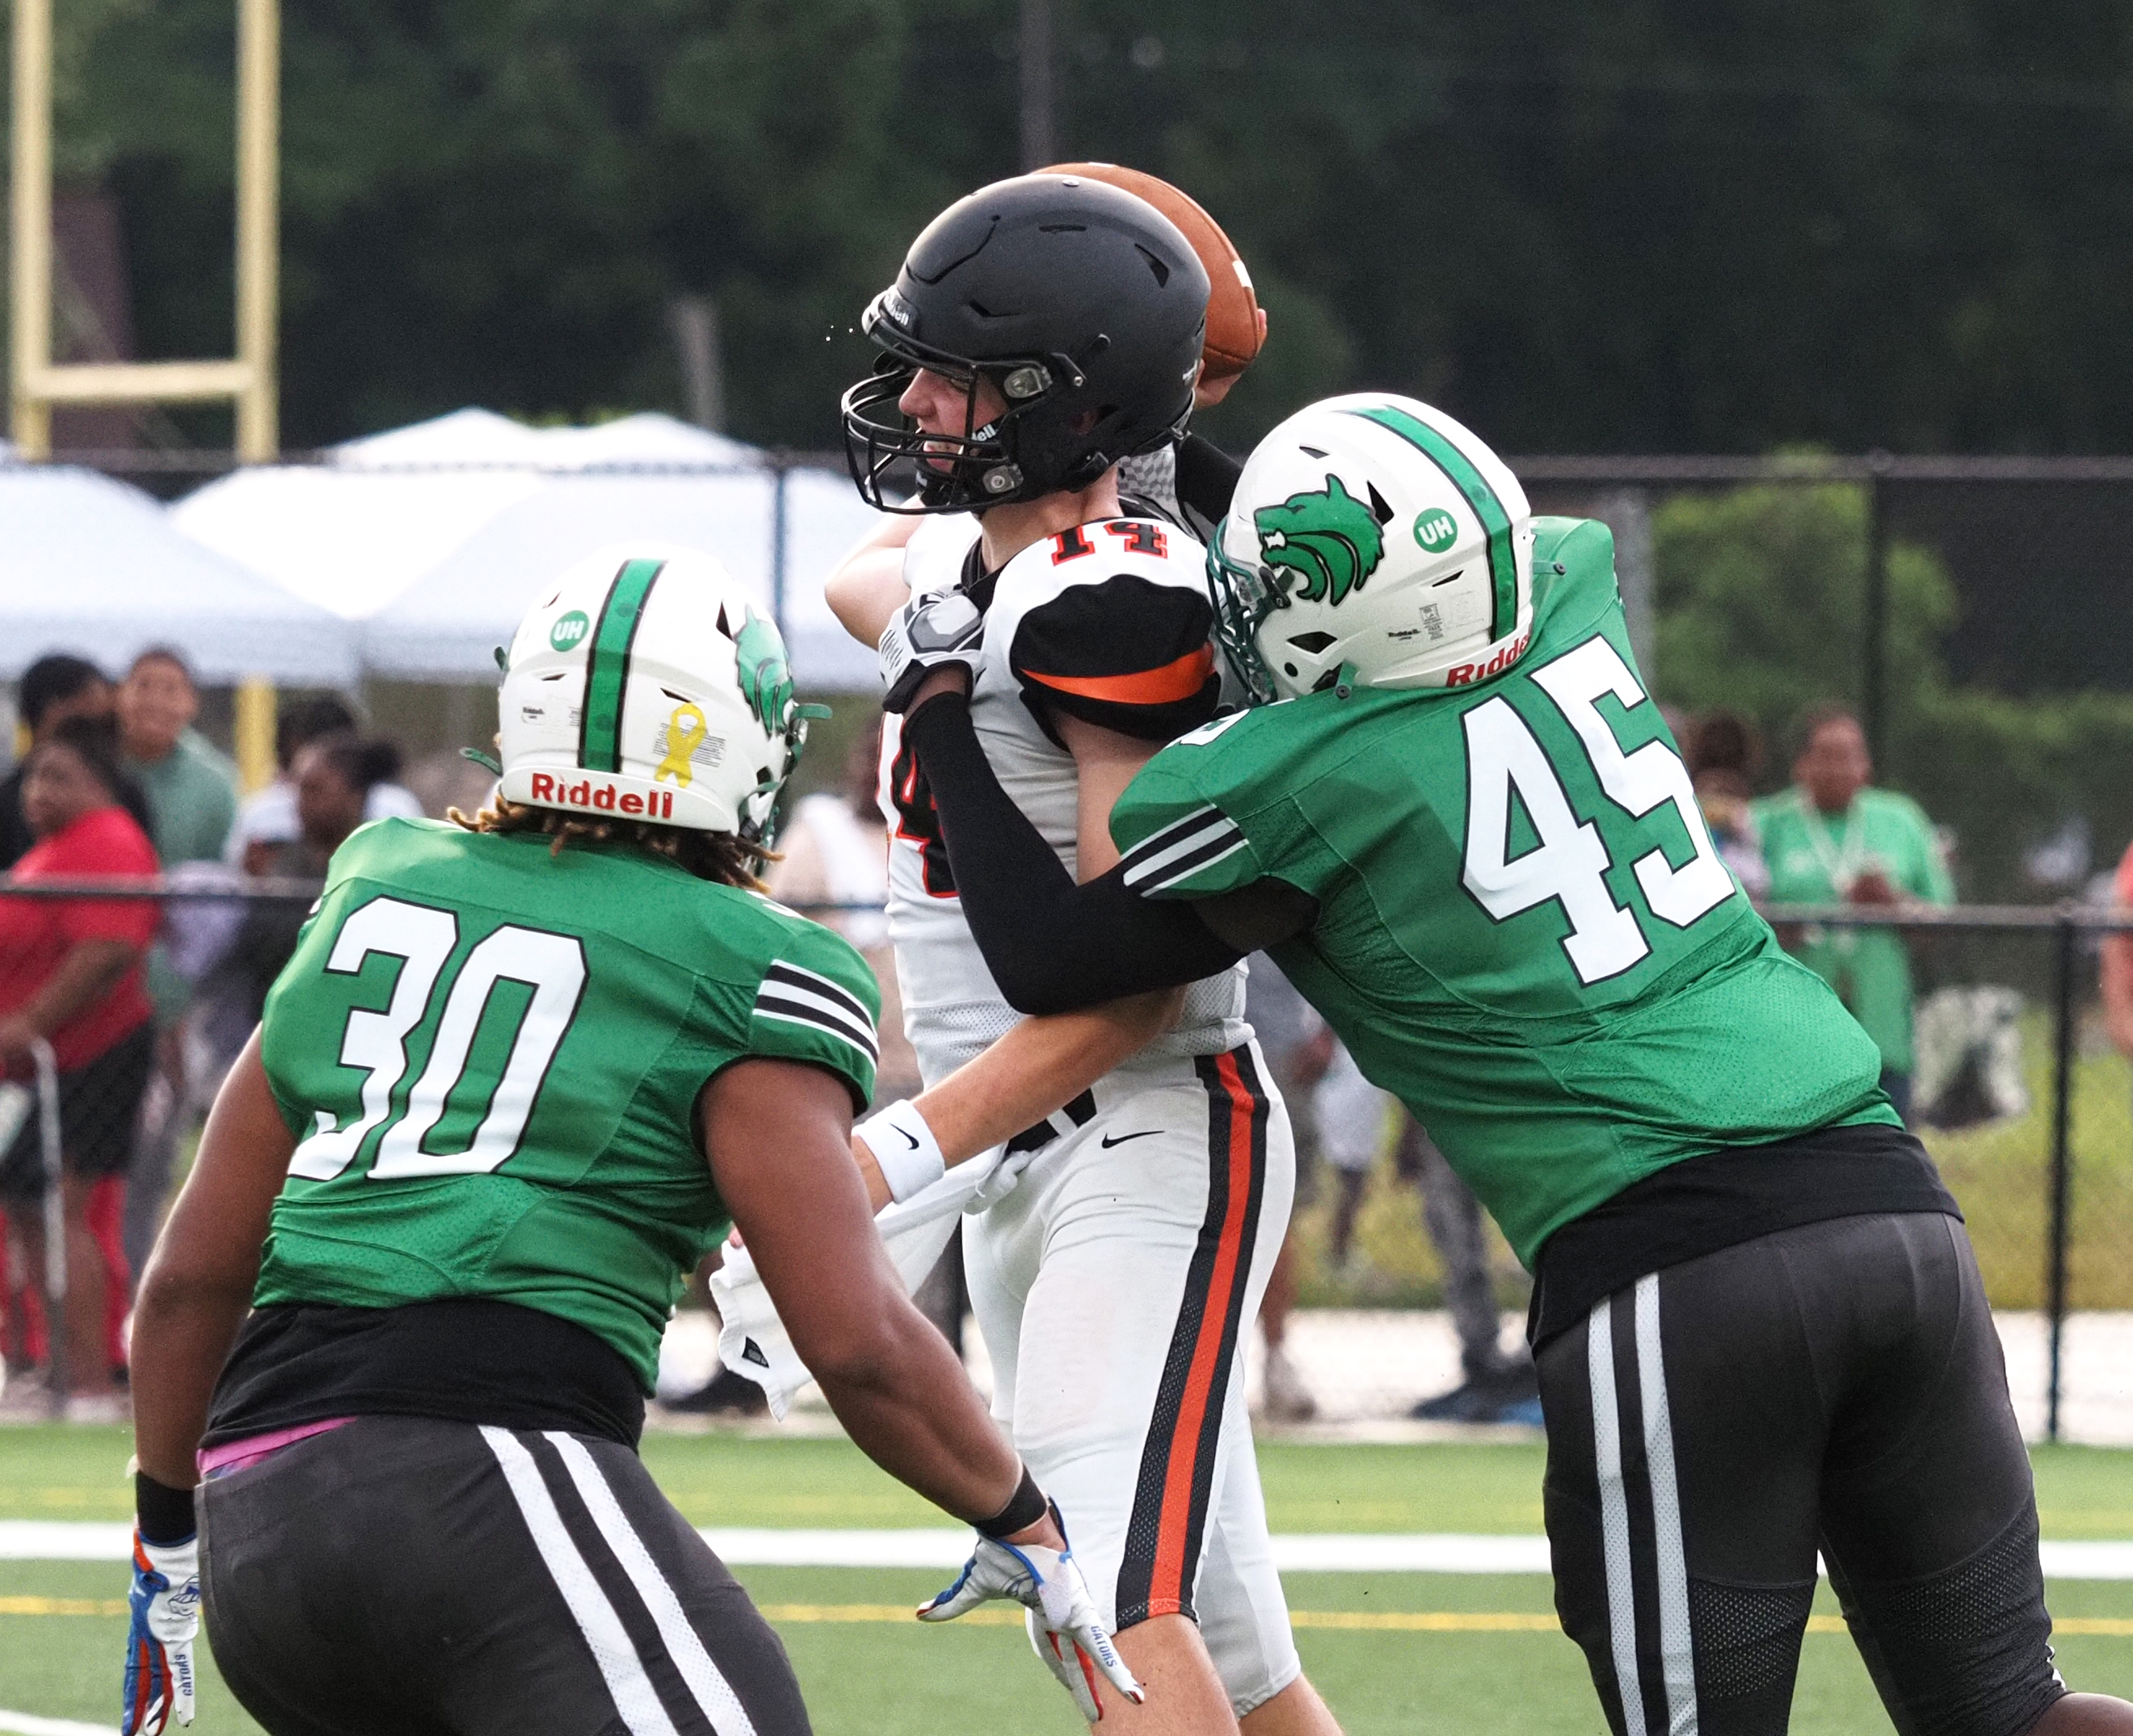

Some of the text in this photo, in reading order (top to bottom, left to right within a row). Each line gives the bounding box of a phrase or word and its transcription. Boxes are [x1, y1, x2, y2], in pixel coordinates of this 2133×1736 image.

[1046, 521, 1167, 567] 14
[1418, 516, 1454, 544] UH
[553, 620, 585, 641] UH
[532, 772, 673, 819] Riddell
[1458, 632, 1737, 988] 45
[288, 893, 591, 1181] 30
[1091, 1625, 1117, 1667] GATORS
[175, 1654, 193, 1696] GATORS
